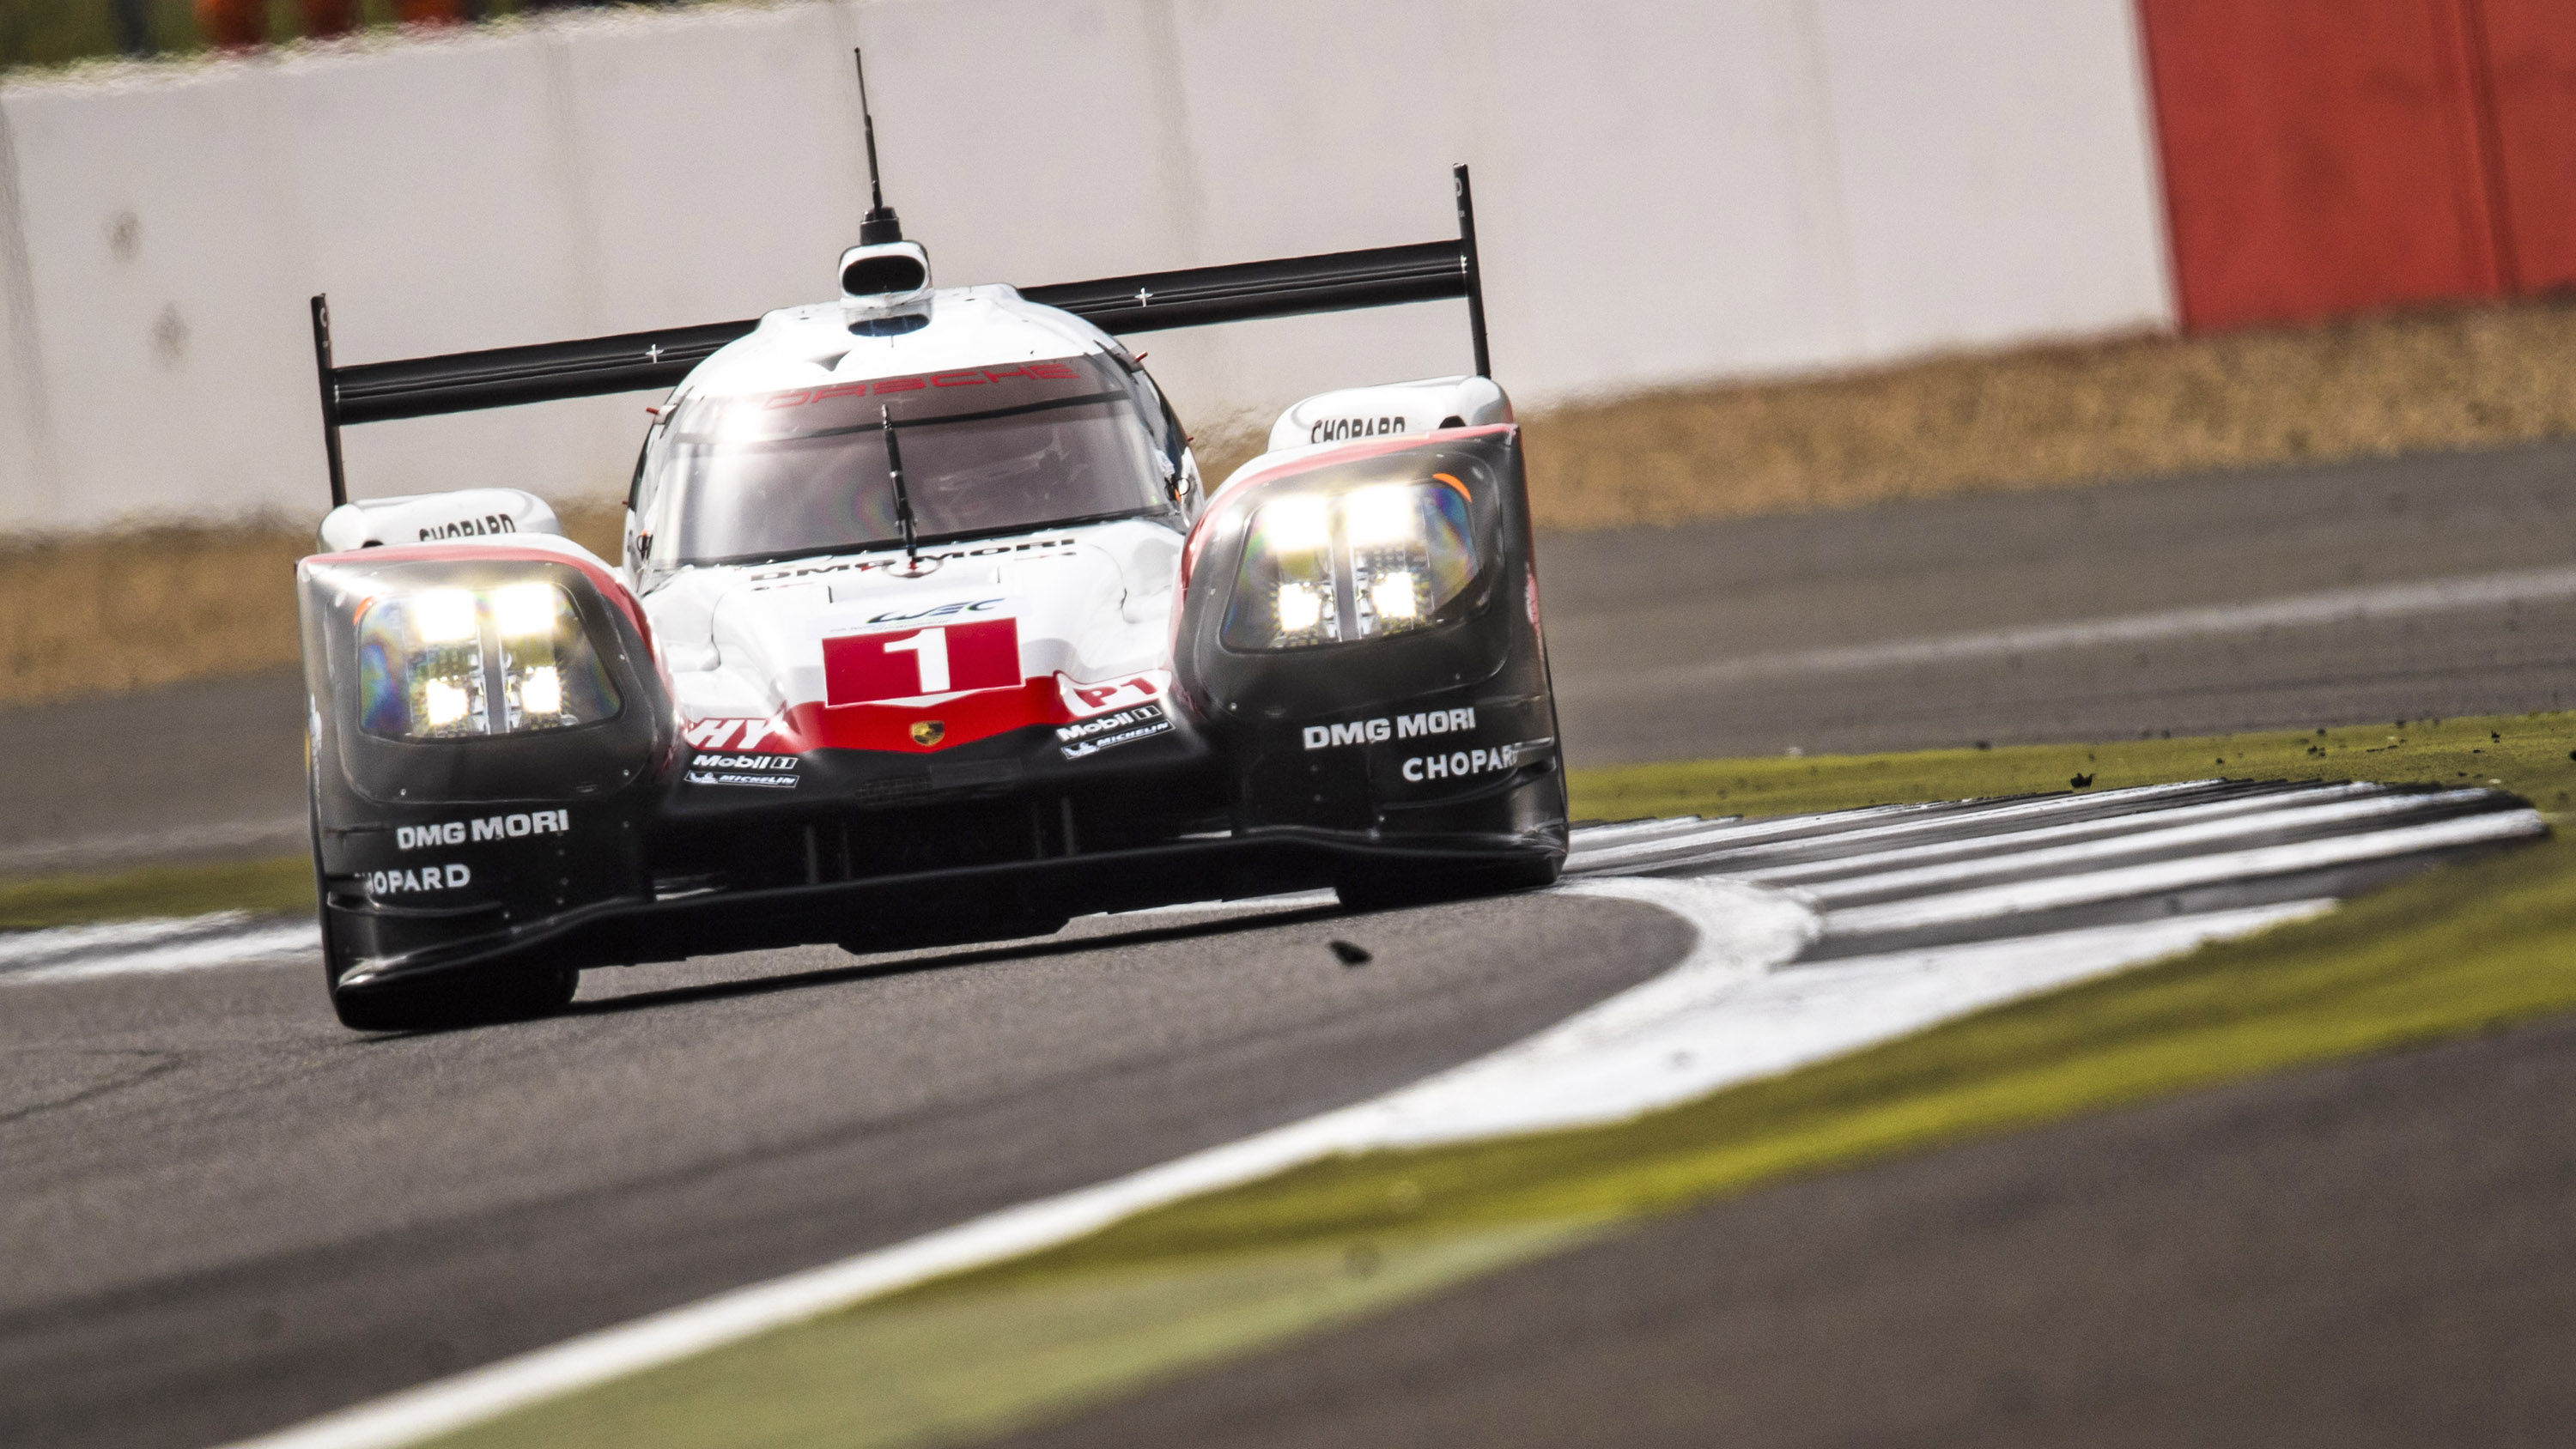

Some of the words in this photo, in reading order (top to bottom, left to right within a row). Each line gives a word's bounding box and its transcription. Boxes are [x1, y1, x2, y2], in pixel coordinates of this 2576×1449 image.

[749, 363, 1080, 410] ORSCHE
[884, 627, 951, 693] 1
[1073, 676, 1158, 708] P1
[687, 719, 777, 749] HY
[1055, 712, 1134, 743] Mobil
[1096, 721, 1170, 747] MICHELIN
[1303, 718, 1392, 750] DMG
[1397, 706, 1476, 738] MORI
[692, 754, 771, 769] Mobil
[1402, 745, 1518, 782] CHOPAR
[718, 774, 796, 785] MICHELIN
[397, 822, 466, 850] DMG
[471, 809, 569, 842] MORI
[354, 864, 471, 894] OPARD
